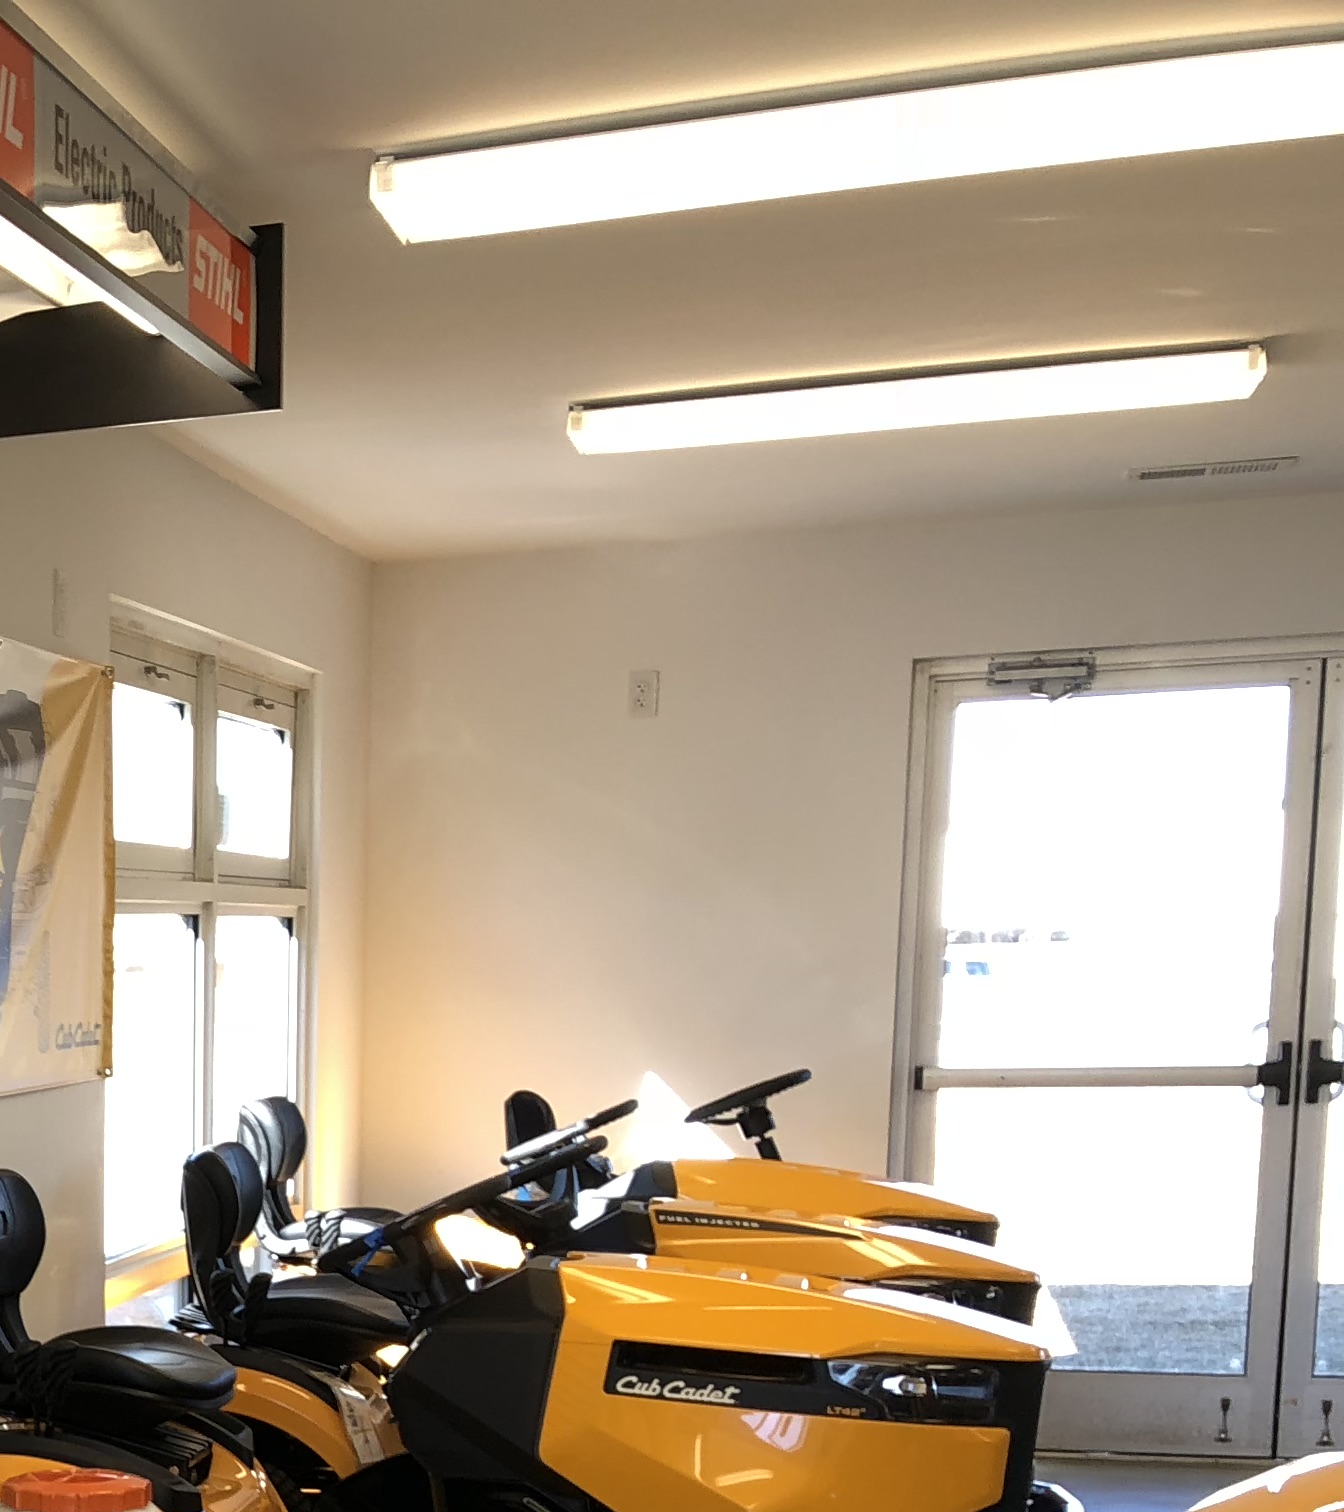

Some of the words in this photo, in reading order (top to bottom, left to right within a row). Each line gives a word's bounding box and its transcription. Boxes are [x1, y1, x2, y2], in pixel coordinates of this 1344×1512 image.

[54, 103, 116, 202] Electric
[122, 162, 183, 263] Products
[193, 233, 244, 321] STIHL
[615, 1375, 660, 1397] Cub
[662, 1379, 741, 1404] Cadet
